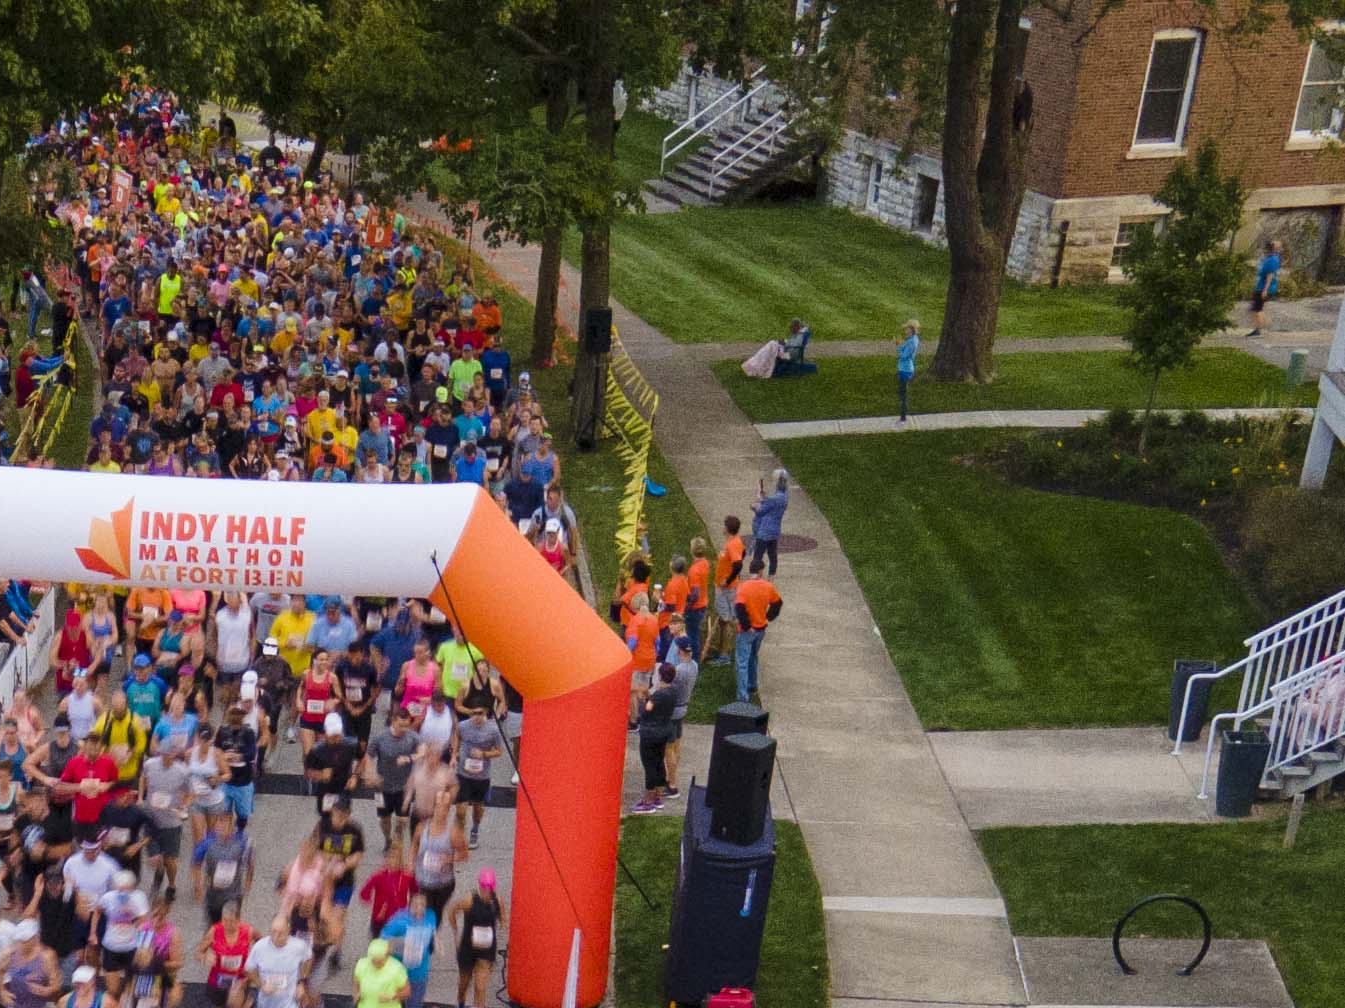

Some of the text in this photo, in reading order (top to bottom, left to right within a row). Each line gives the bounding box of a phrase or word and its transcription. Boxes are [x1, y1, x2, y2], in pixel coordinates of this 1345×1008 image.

[140, 511, 306, 545] INDY HALF
[139, 543, 304, 567] MARATHON
[140, 564, 169, 581] AT
[176, 566, 238, 585] FORT
